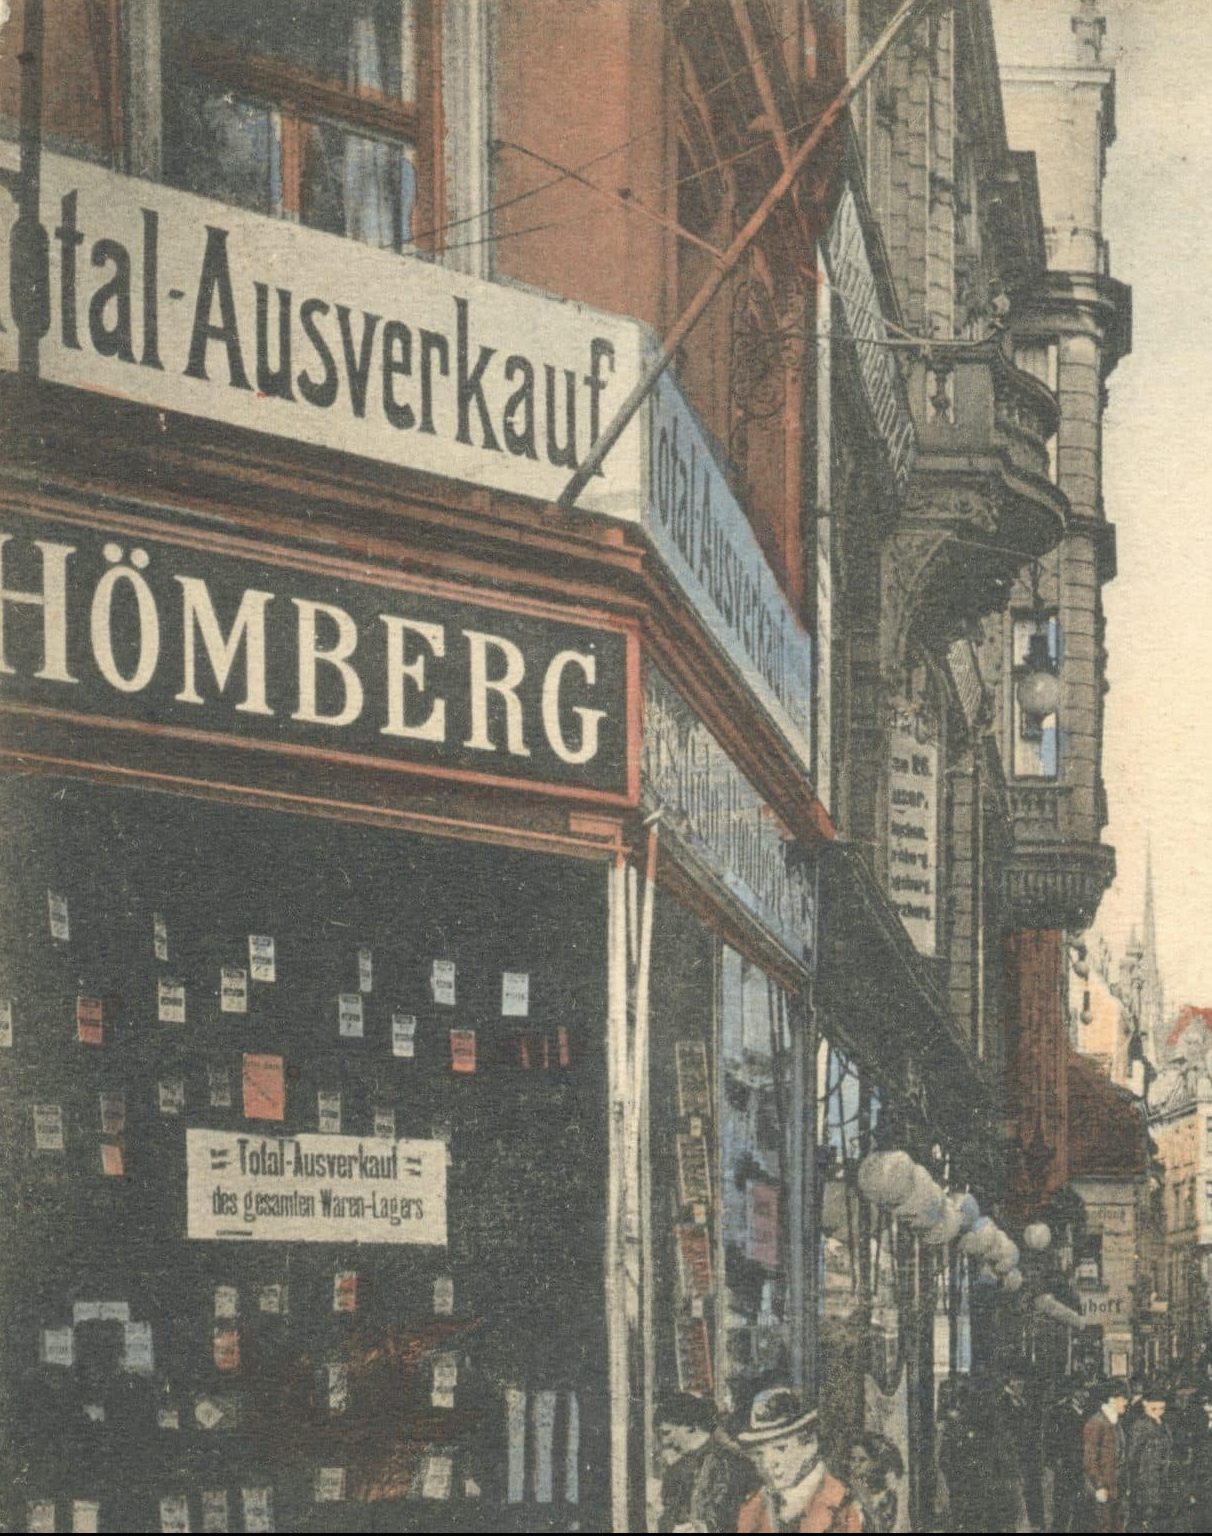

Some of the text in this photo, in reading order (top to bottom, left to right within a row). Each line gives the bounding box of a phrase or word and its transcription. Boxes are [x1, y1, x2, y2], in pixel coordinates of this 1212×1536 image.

[236, 1138, 398, 1181] Total-Ausverkauf
[212, 1185, 425, 1227] des gesamten Waren-Lagers
